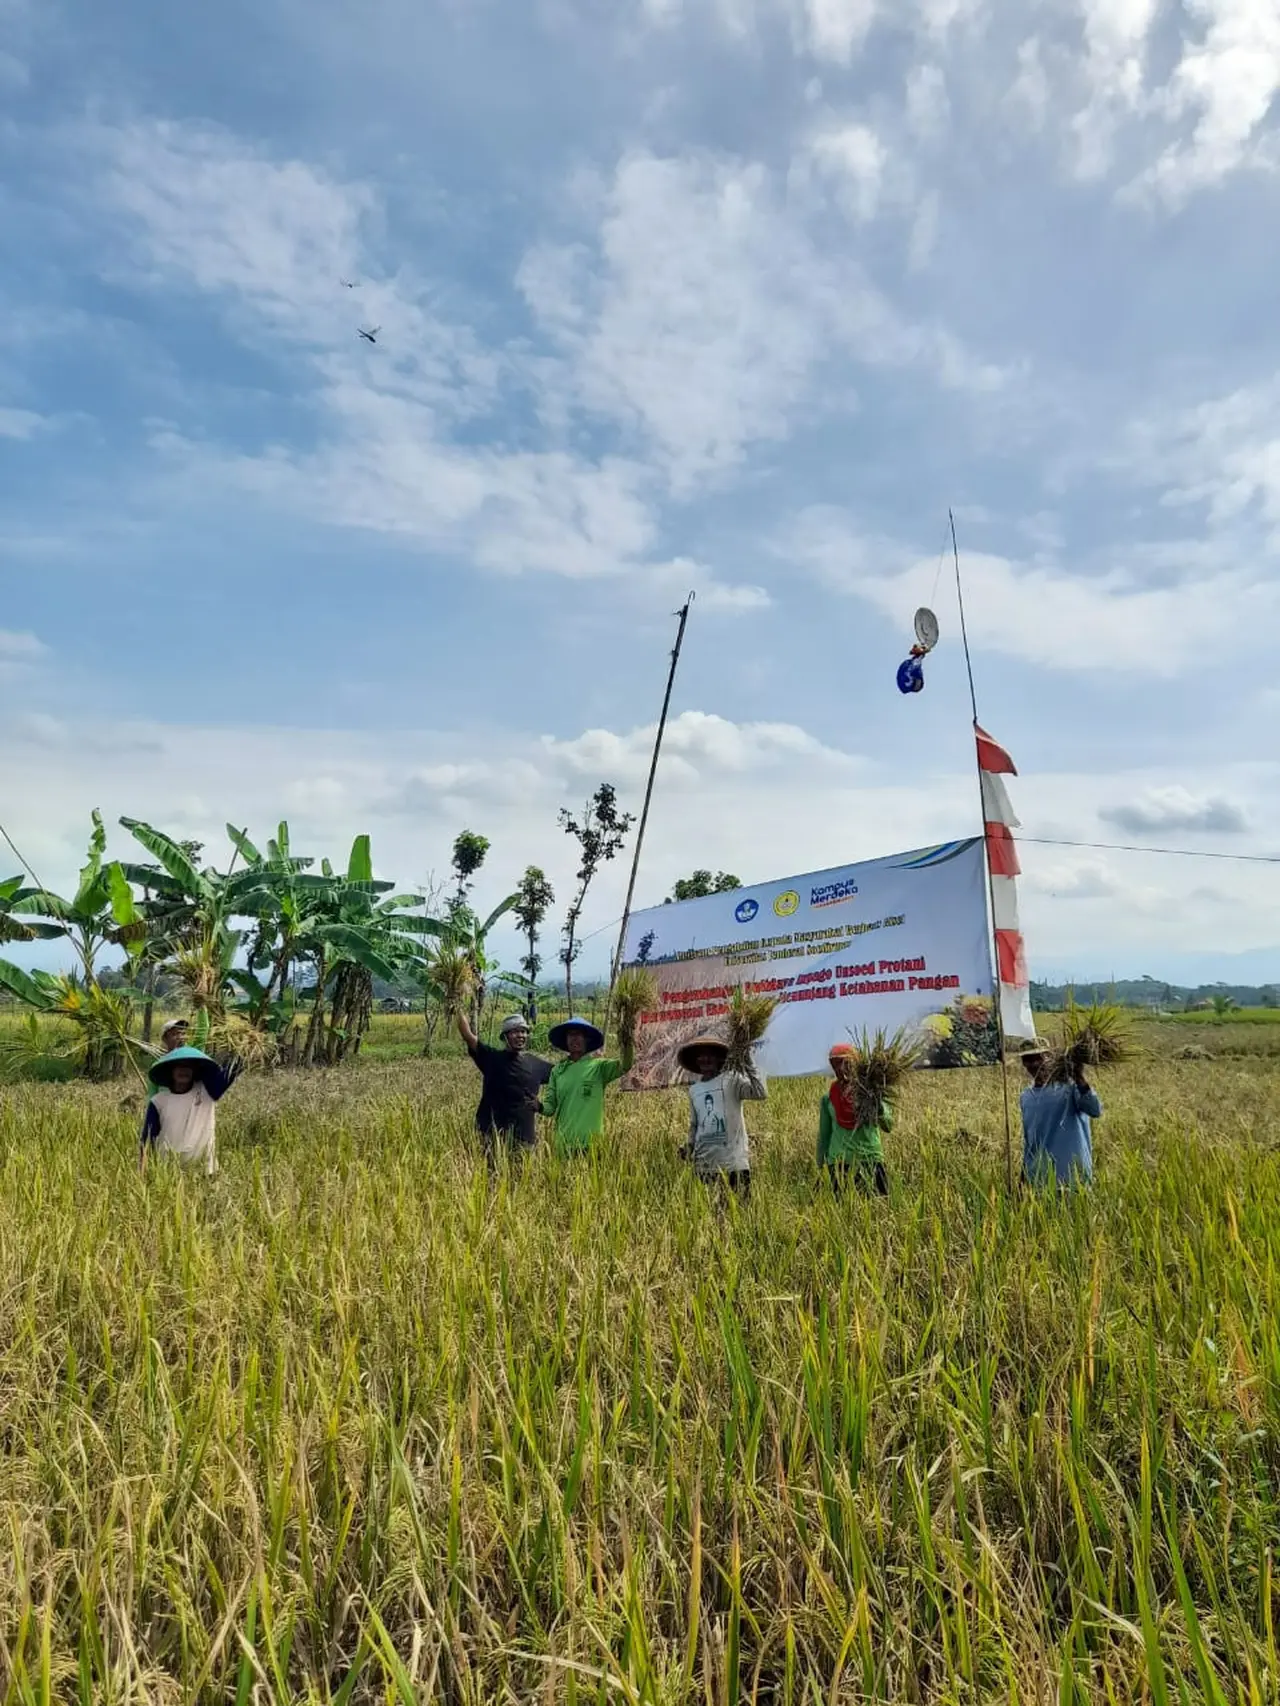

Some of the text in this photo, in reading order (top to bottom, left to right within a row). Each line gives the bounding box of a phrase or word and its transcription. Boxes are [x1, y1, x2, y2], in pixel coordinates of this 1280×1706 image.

[810, 886, 858, 905] Merdeka
[811, 879, 854, 896] Kampus
[836, 961, 875, 978] Unsoed
[879, 955, 926, 974] Protani
[840, 976, 905, 997] Ketahanan
[908, 973, 960, 991] Pangan
